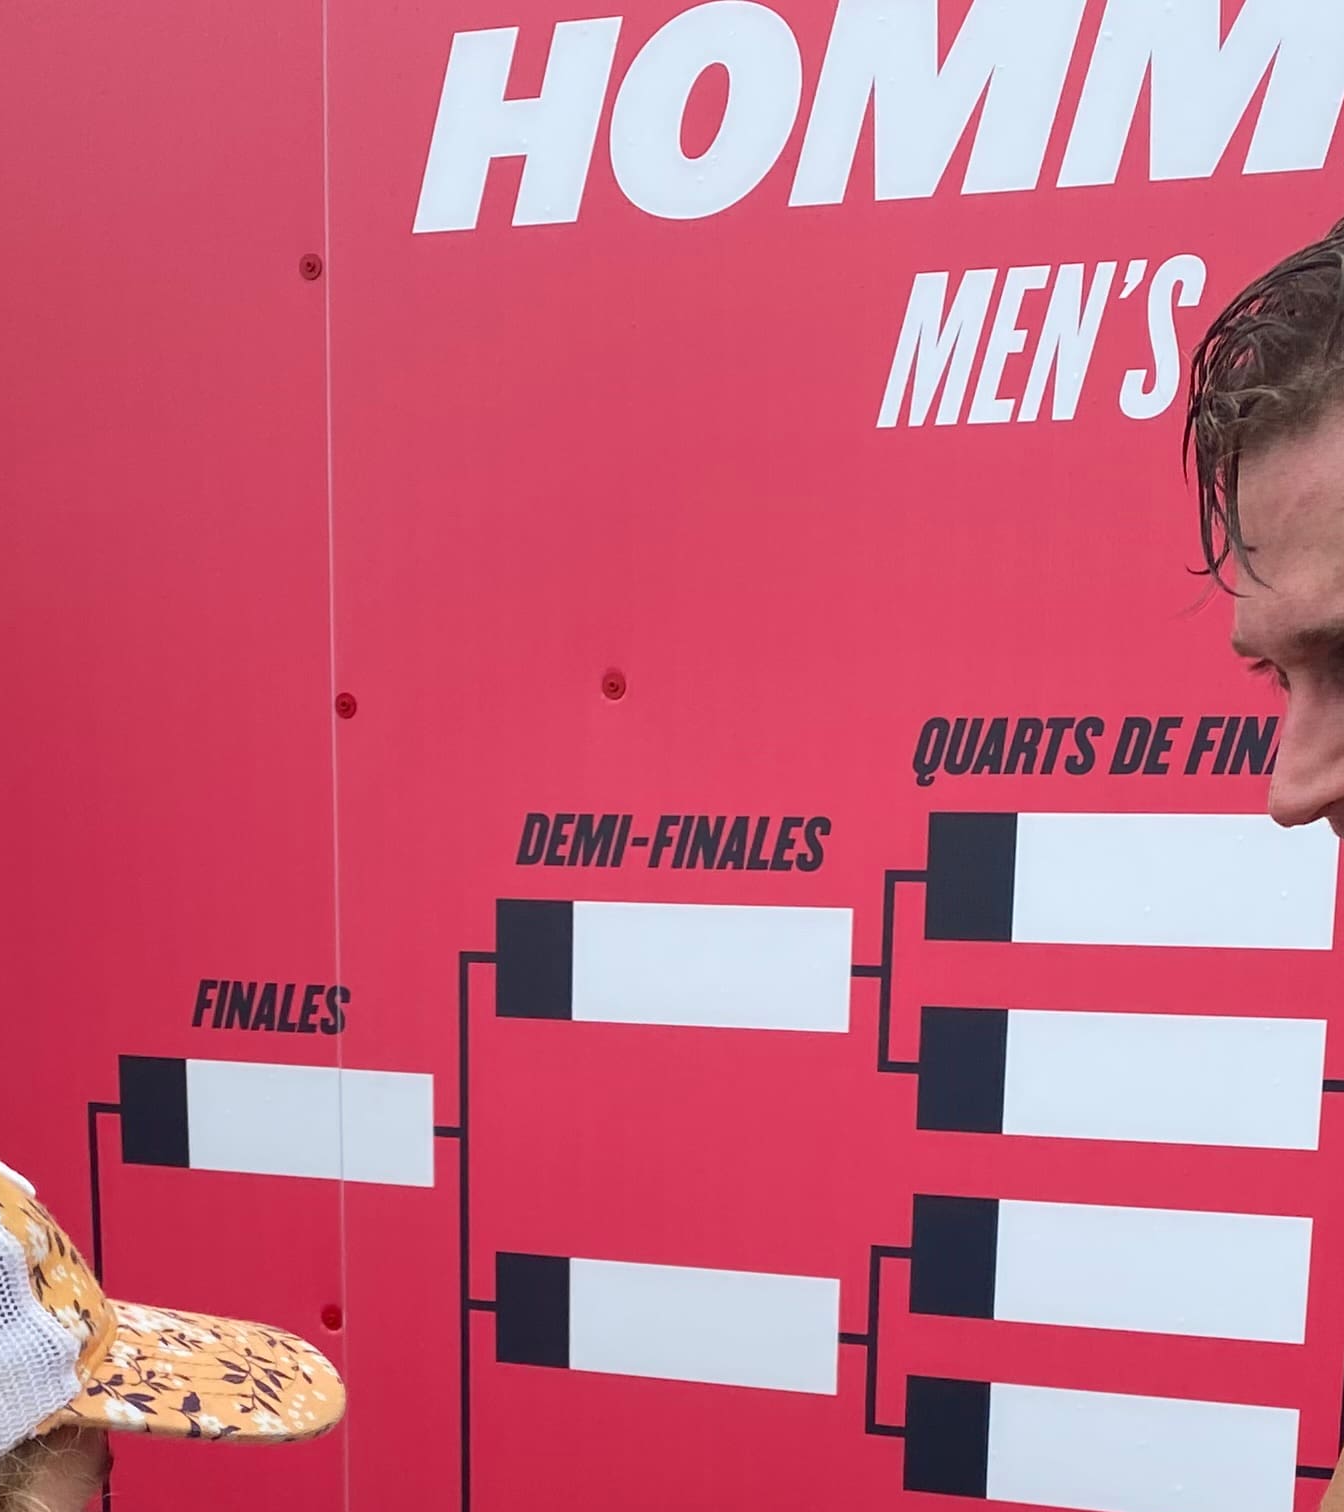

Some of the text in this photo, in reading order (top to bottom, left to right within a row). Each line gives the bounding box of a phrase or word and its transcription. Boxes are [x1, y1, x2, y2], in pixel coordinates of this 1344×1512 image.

[876, 254, 1206, 428] MEN'S
[912, 717, 1105, 787] QUARTS
[1109, 716, 1184, 775] DE
[1184, 716, 1280, 775] FIN
[516, 813, 831, 872] DEMI-FINALES
[192, 979, 351, 1035] FINALES
